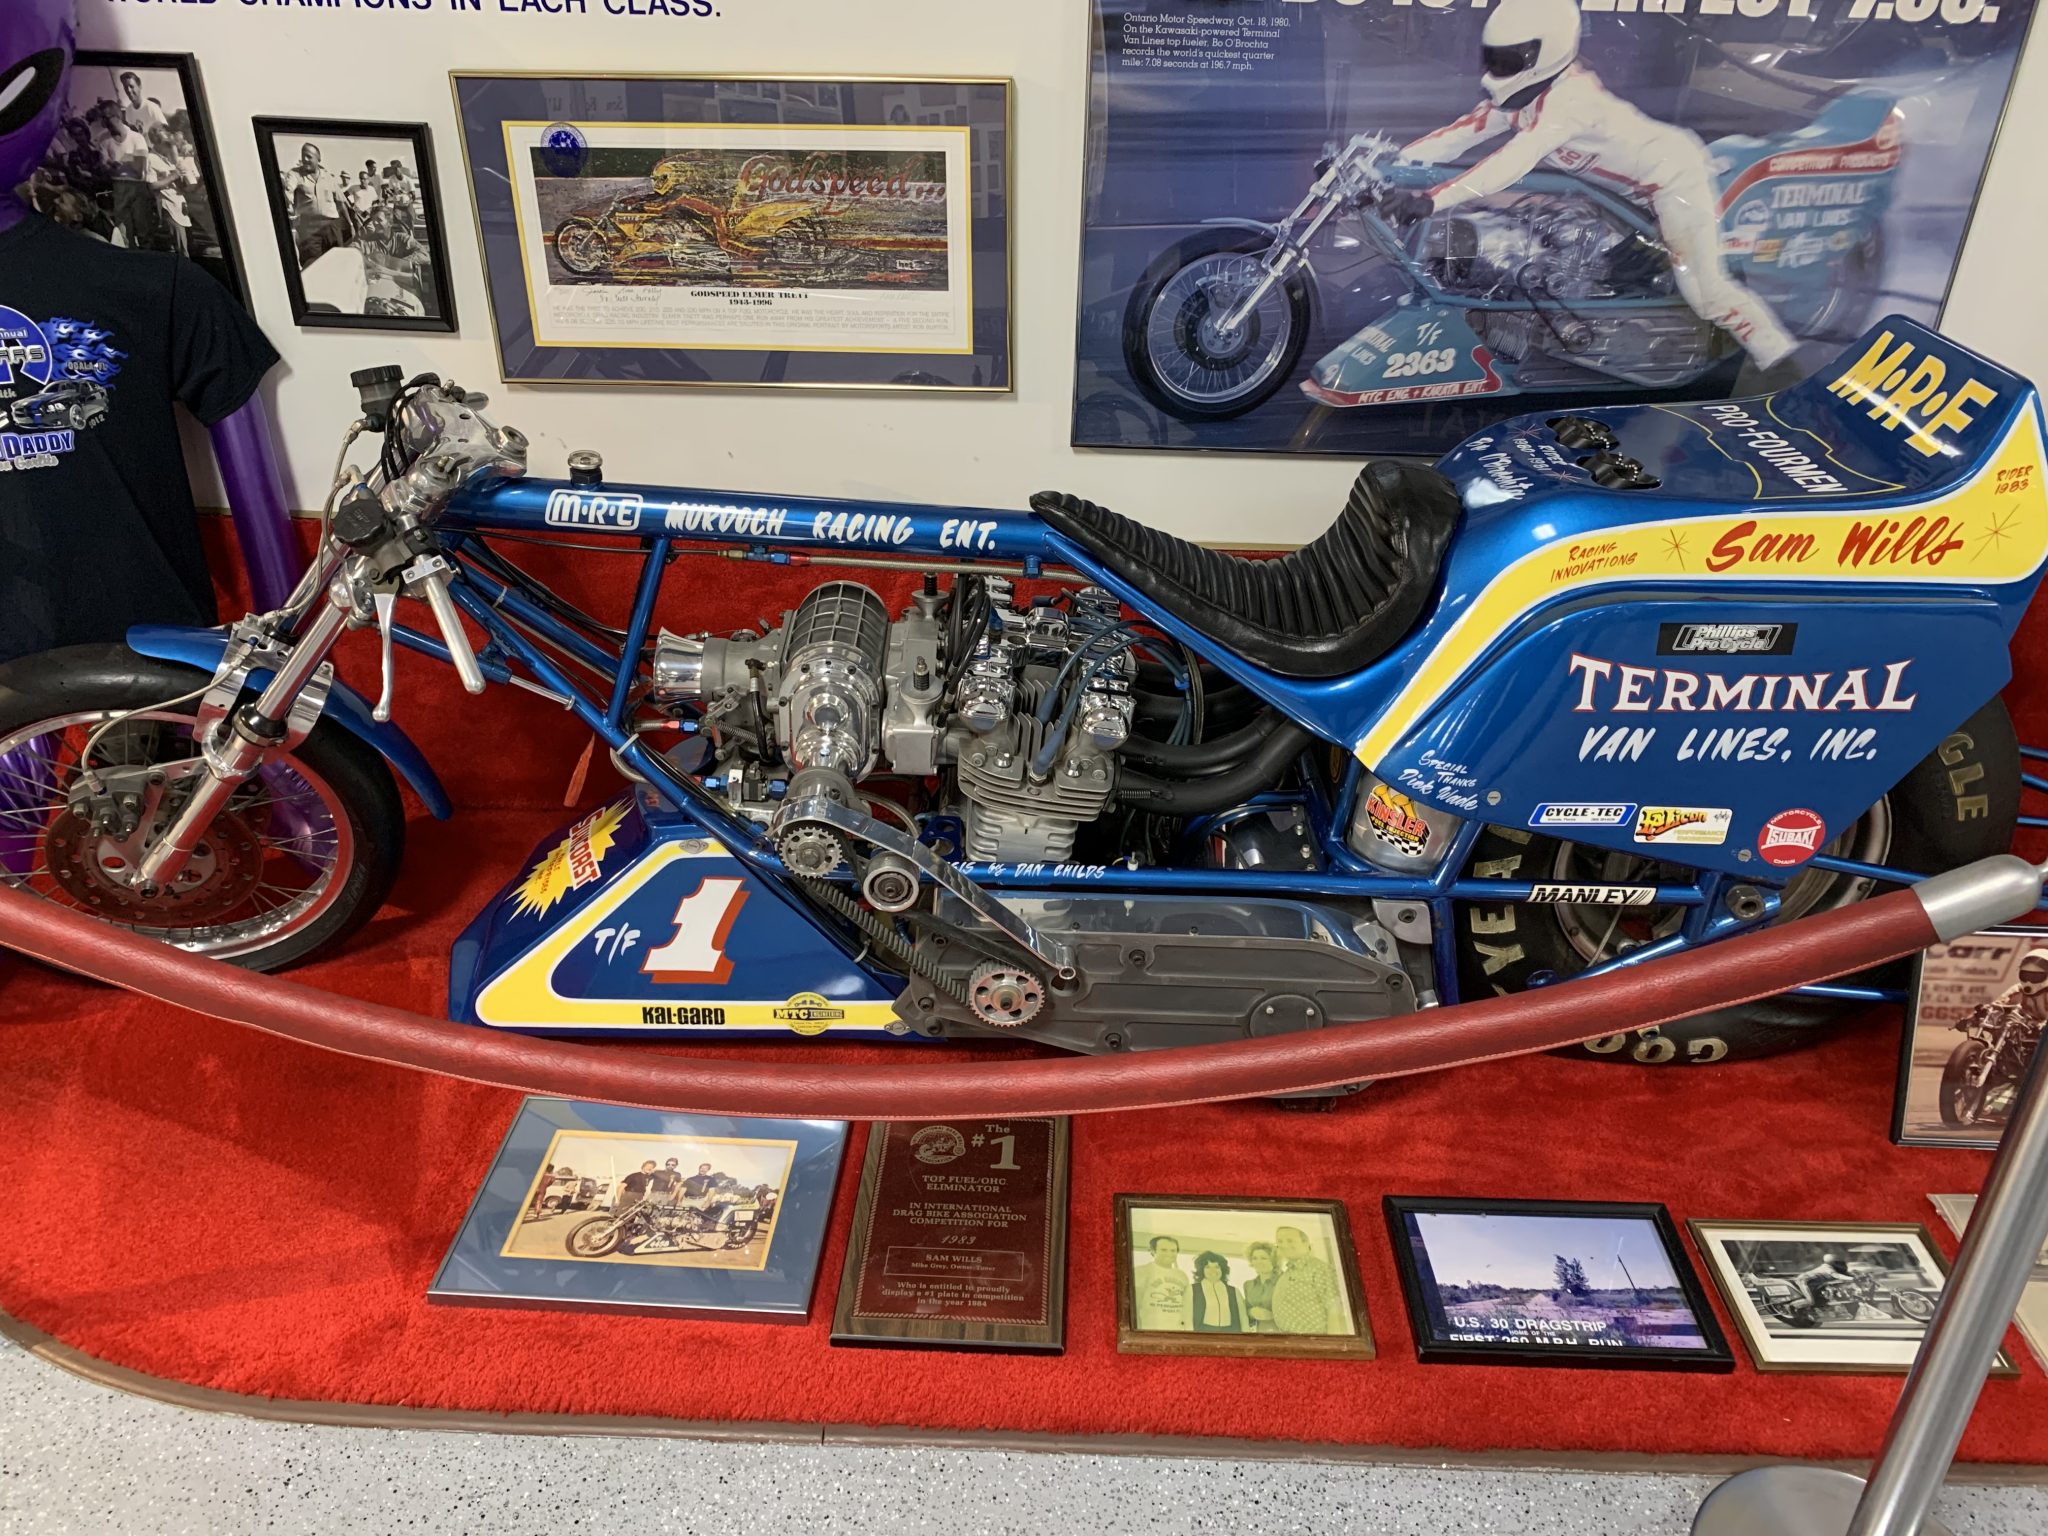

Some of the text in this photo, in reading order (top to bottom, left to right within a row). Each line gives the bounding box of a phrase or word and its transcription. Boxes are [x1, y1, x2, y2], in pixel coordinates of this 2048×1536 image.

[1124, 13, 1158, 22] Ontario
[1160, 14, 1185, 23] Motor
[1187, 15, 1234, 26] Speedway,
[1238, 16, 1255, 26] Oct.
[1258, 17, 1268, 27] 18,
[1123, 24, 1280, 38] On the Kawasaki-powered Terminal
[1123, 35, 1139, 44] Van
[1142, 36, 1164, 45] Lines
[1167, 37, 1181, 47] top
[1212, 38, 1223, 47] Bo
[1225, 39, 1269, 49] O'Brochta
[1122, 47, 1275, 61] records the world's quickest quarter
[1122, 58, 1143, 67] mile:
[1145, 58, 1162, 67] 7.08
[1163, 58, 1199, 68] seconds
[1200, 60, 1209, 69] at
[1232, 61, 1254, 71] mph.
[1770, 183, 1870, 209] TERMINAL
[1776, 211, 1806, 230] VAN
[690, 290, 740, 298] GODSPEED
[1382, 348, 1456, 379] 2363
[2, 432, 73, 460] DADDY
[1702, 404, 1848, 493] PRO-FOURMEN
[1996, 465, 2034, 480] RIDER
[1995, 479, 2030, 495] 1983
[664, 501, 998, 551] MURDOCH RACING ENT.
[1706, 515, 1964, 573] Sam Wills
[1550, 551, 1639, 583] INNOVATIONS
[1694, 625, 1758, 640] Phillips
[1568, 653, 1917, 712] TERMINAL
[1578, 725, 1656, 763] VAN
[1810, 728, 1878, 762] INC.
[1937, 732, 1989, 822] GLE
[1436, 786, 1479, 811] Wade
[1366, 794, 1427, 838] KINSLER
[1770, 809, 1823, 826] MOTORCYCLE
[1014, 863, 1046, 877] DAN
[1053, 864, 1107, 879] CHILDS
[1532, 887, 1638, 905] MANLEY
[641, 876, 750, 985] 1
[594, 921, 641, 966] T/F
[776, 1008, 809, 1020] MTC
[985, 1124, 1010, 1134] The
[922, 1174, 945, 1183] TOP
[926, 1182, 1000, 1193] ELIMINATOR
[892, 1208, 1027, 1221] DRAG BIKE ASSOCIATION
[909, 1202, 1012, 1213] IN INTERNATIONAL
[909, 1217, 1009, 1228] COMPETITION FOR
[926, 1253, 983, 1264] SAM WILLS
[881, 1288, 914, 1298] display
[937, 1290, 959, 1299] plate
[972, 1292, 1025, 1302] competition
[896, 1281, 917, 1289] Who
[965, 1283, 975, 1291] to
[977, 1285, 1010, 1294] proudly
[929, 1297, 942, 1305] the
[945, 1299, 964, 1307] year
[1454, 1316, 1607, 1332] U.S. 30 DRAGSTRIP
